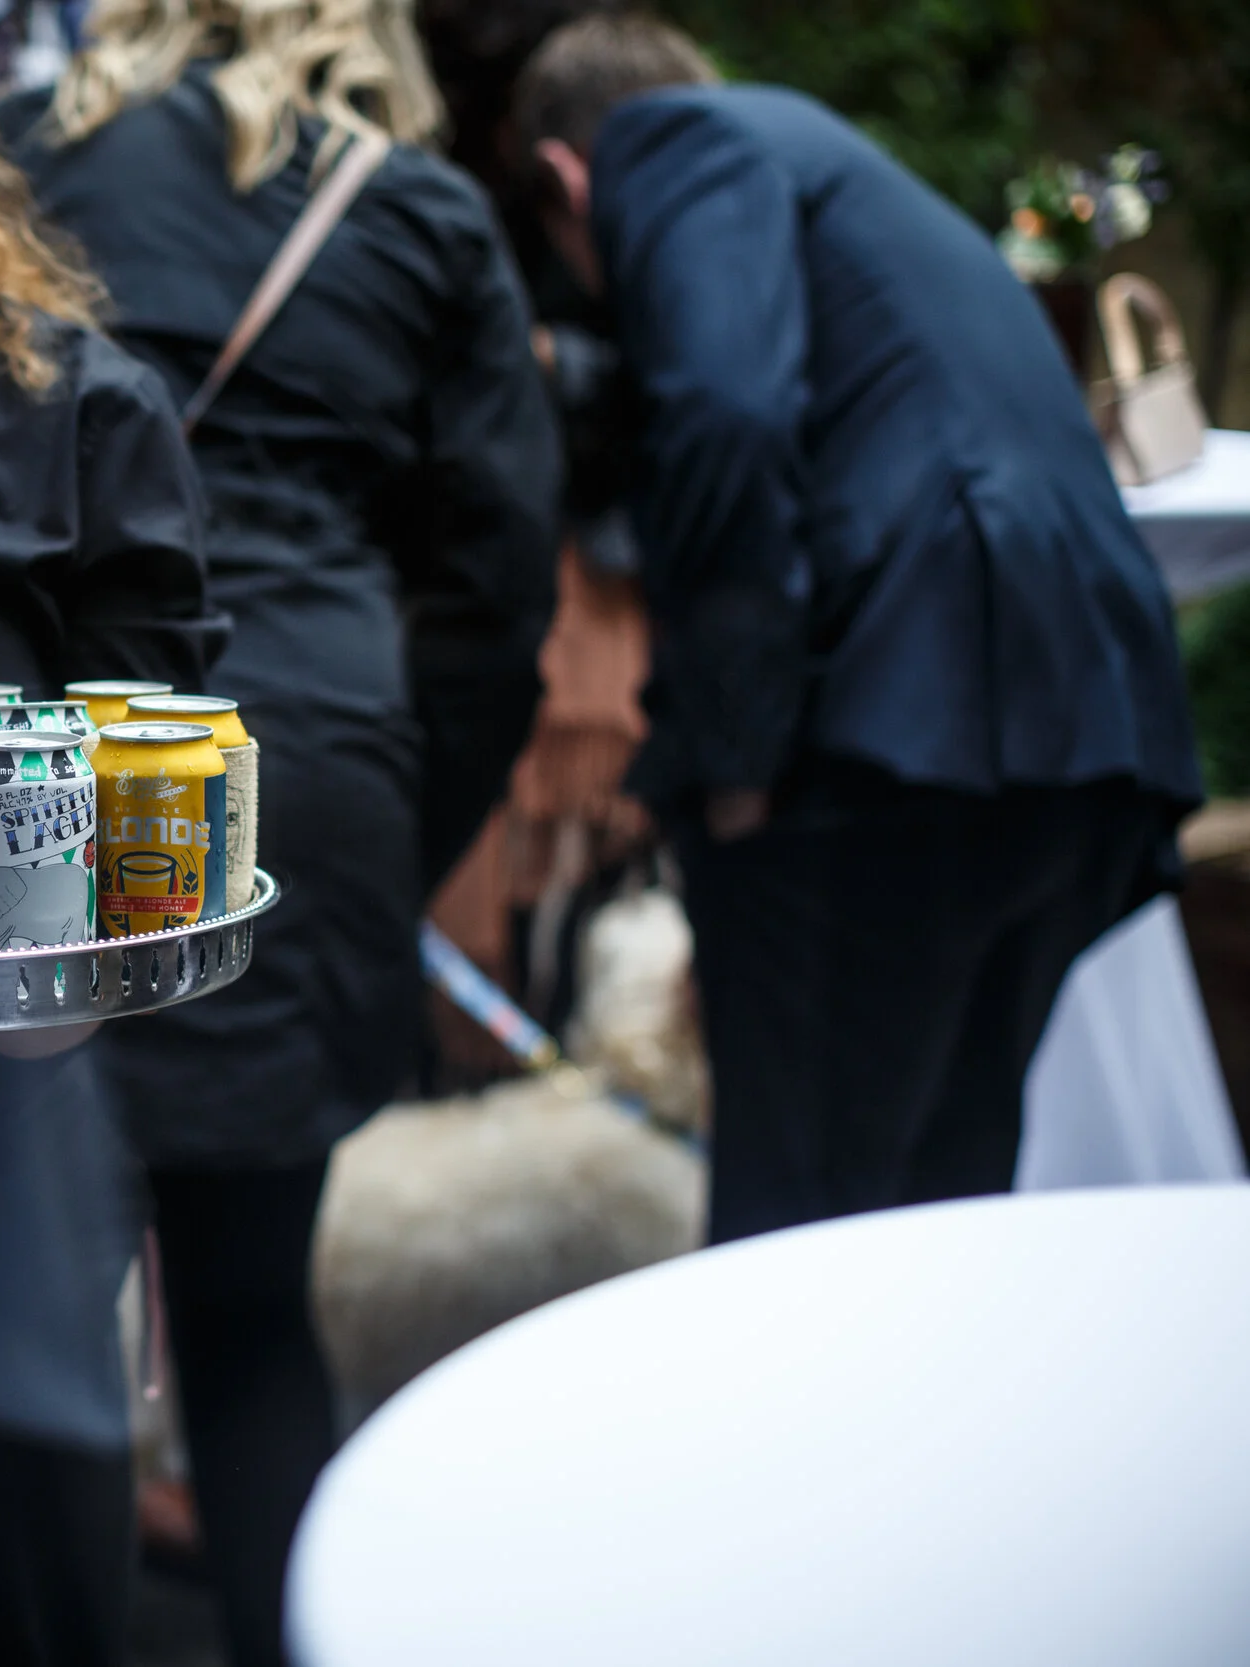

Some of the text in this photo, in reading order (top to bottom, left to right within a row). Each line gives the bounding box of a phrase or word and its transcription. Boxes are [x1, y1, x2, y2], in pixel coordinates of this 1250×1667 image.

[0, 781, 95, 830] SPITEFUL
[5, 791, 18, 800] FL.
[19, 787, 32, 796] OZ
[37, 793, 47, 801] BY
[50, 786, 68, 797] VOL.
[4, 798, 95, 856] LAGER
